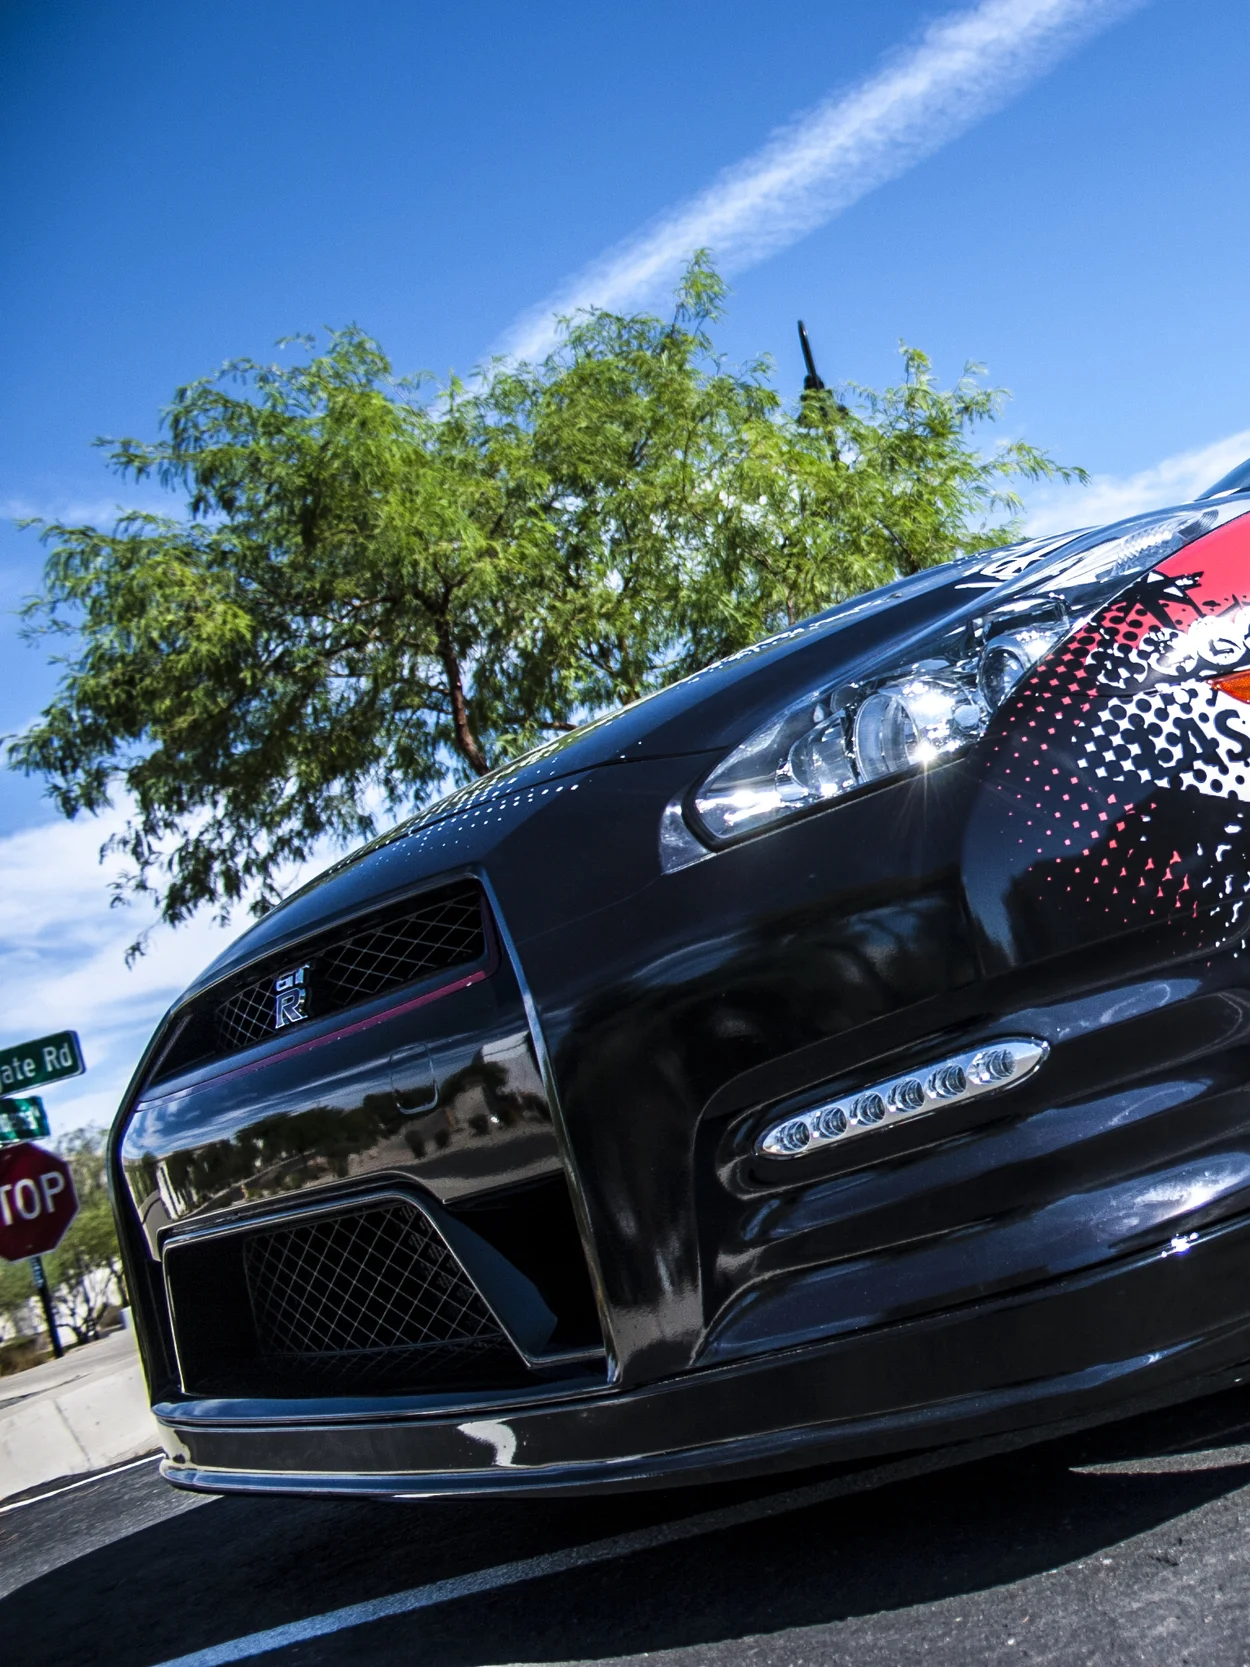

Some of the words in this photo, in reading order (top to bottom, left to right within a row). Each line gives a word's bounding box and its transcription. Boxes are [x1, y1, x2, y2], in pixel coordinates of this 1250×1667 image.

[0, 1056, 36, 1090] ate
[42, 1042, 73, 1072] Rd
[0, 1171, 65, 1226] TOP
